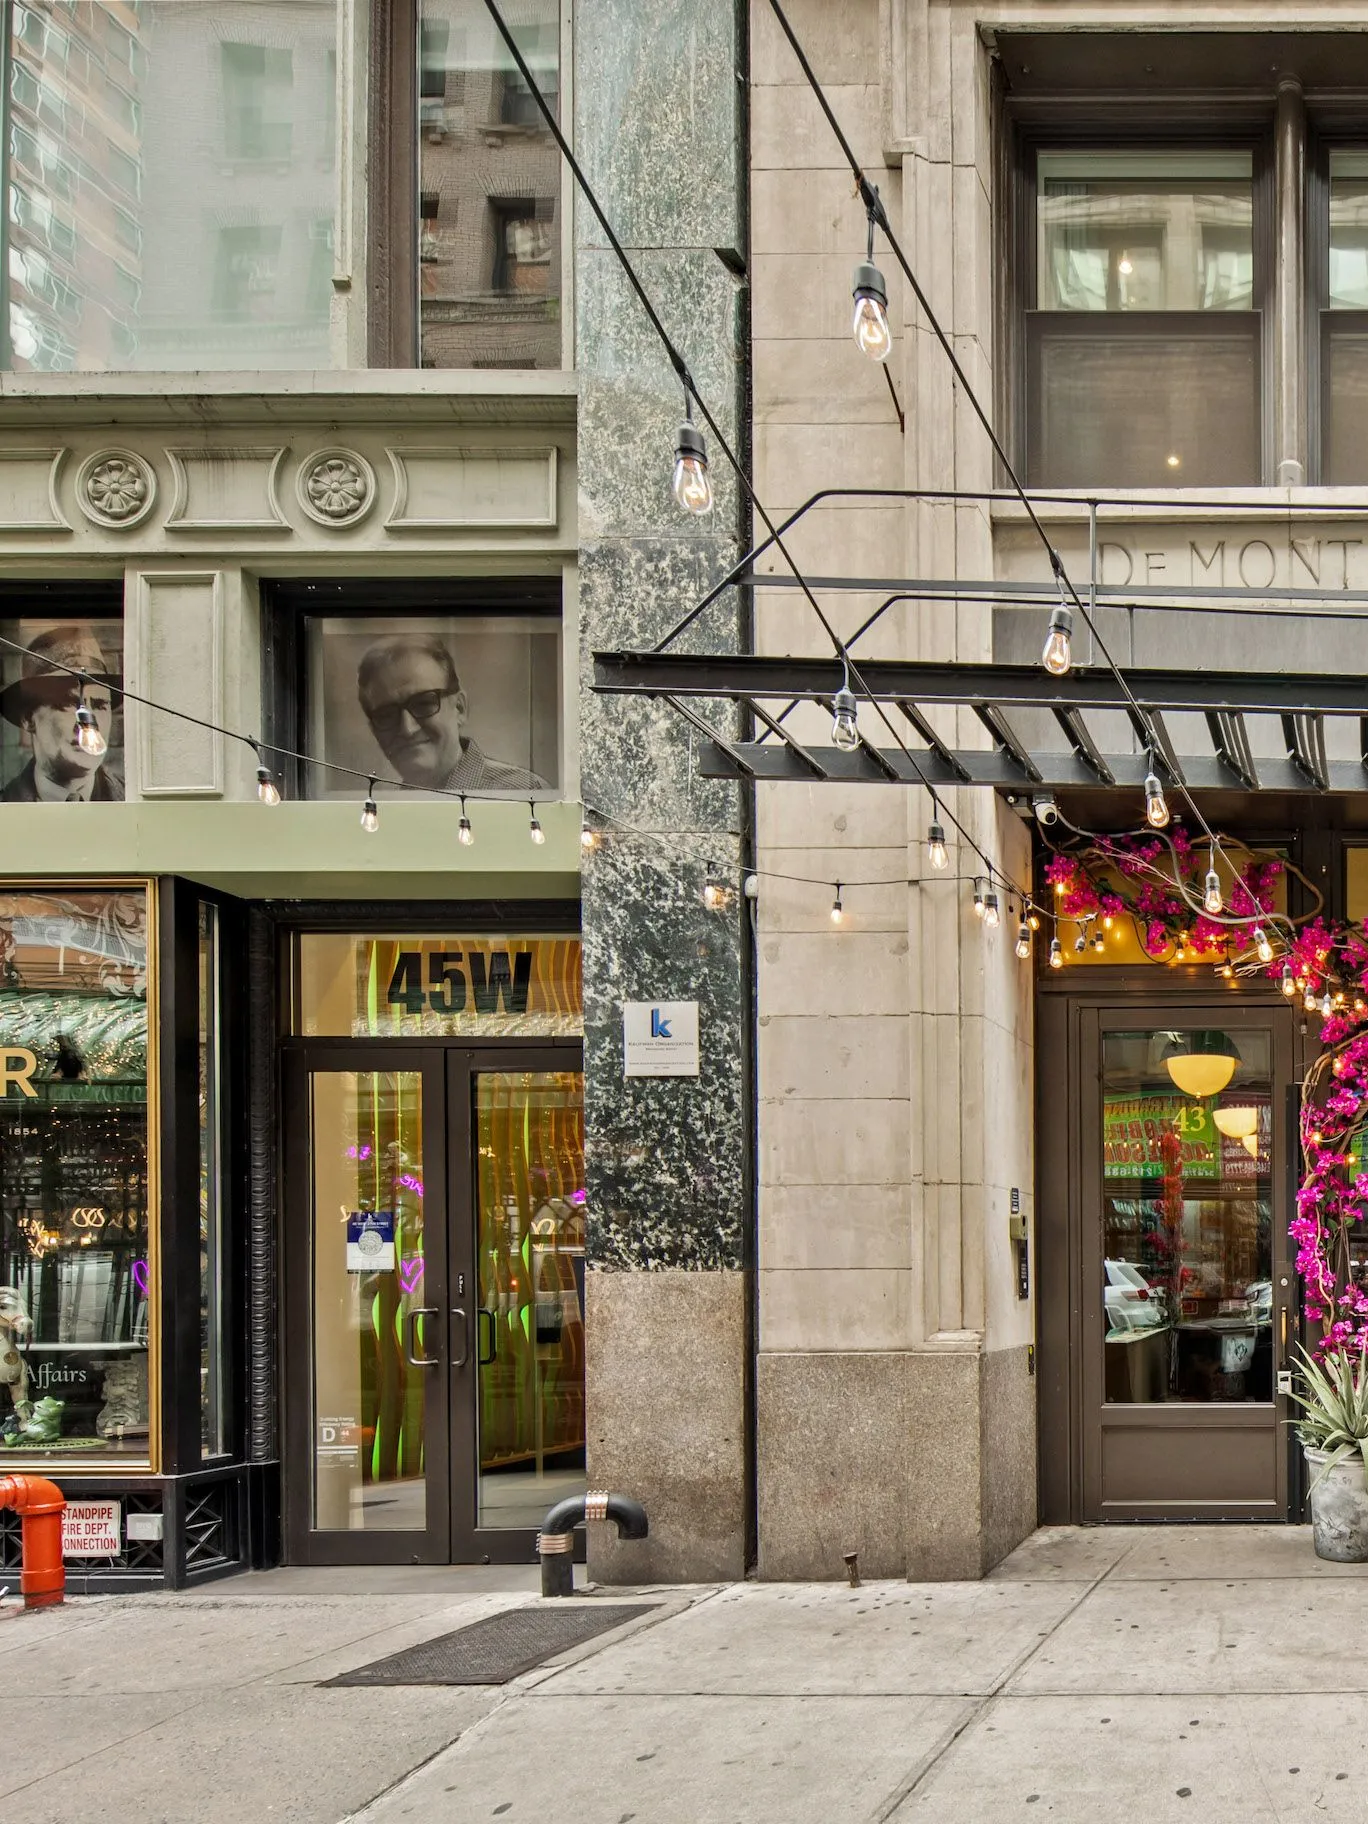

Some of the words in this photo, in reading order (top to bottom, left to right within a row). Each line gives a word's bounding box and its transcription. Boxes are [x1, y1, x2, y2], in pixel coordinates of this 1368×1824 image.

[388, 952, 532, 1014] 45W
[1172, 1106, 1206, 1132] 43
[9, 1127, 38, 1136] 1854
[26, 1362, 87, 1389] Affairs
[322, 1427, 336, 1442] D
[61, 1507, 112, 1520] STANDPIPE
[61, 1523, 82, 1535] FIRE
[85, 1523, 111, 1535] DEPT.
[62, 1538, 117, 1550] ONNECTION
